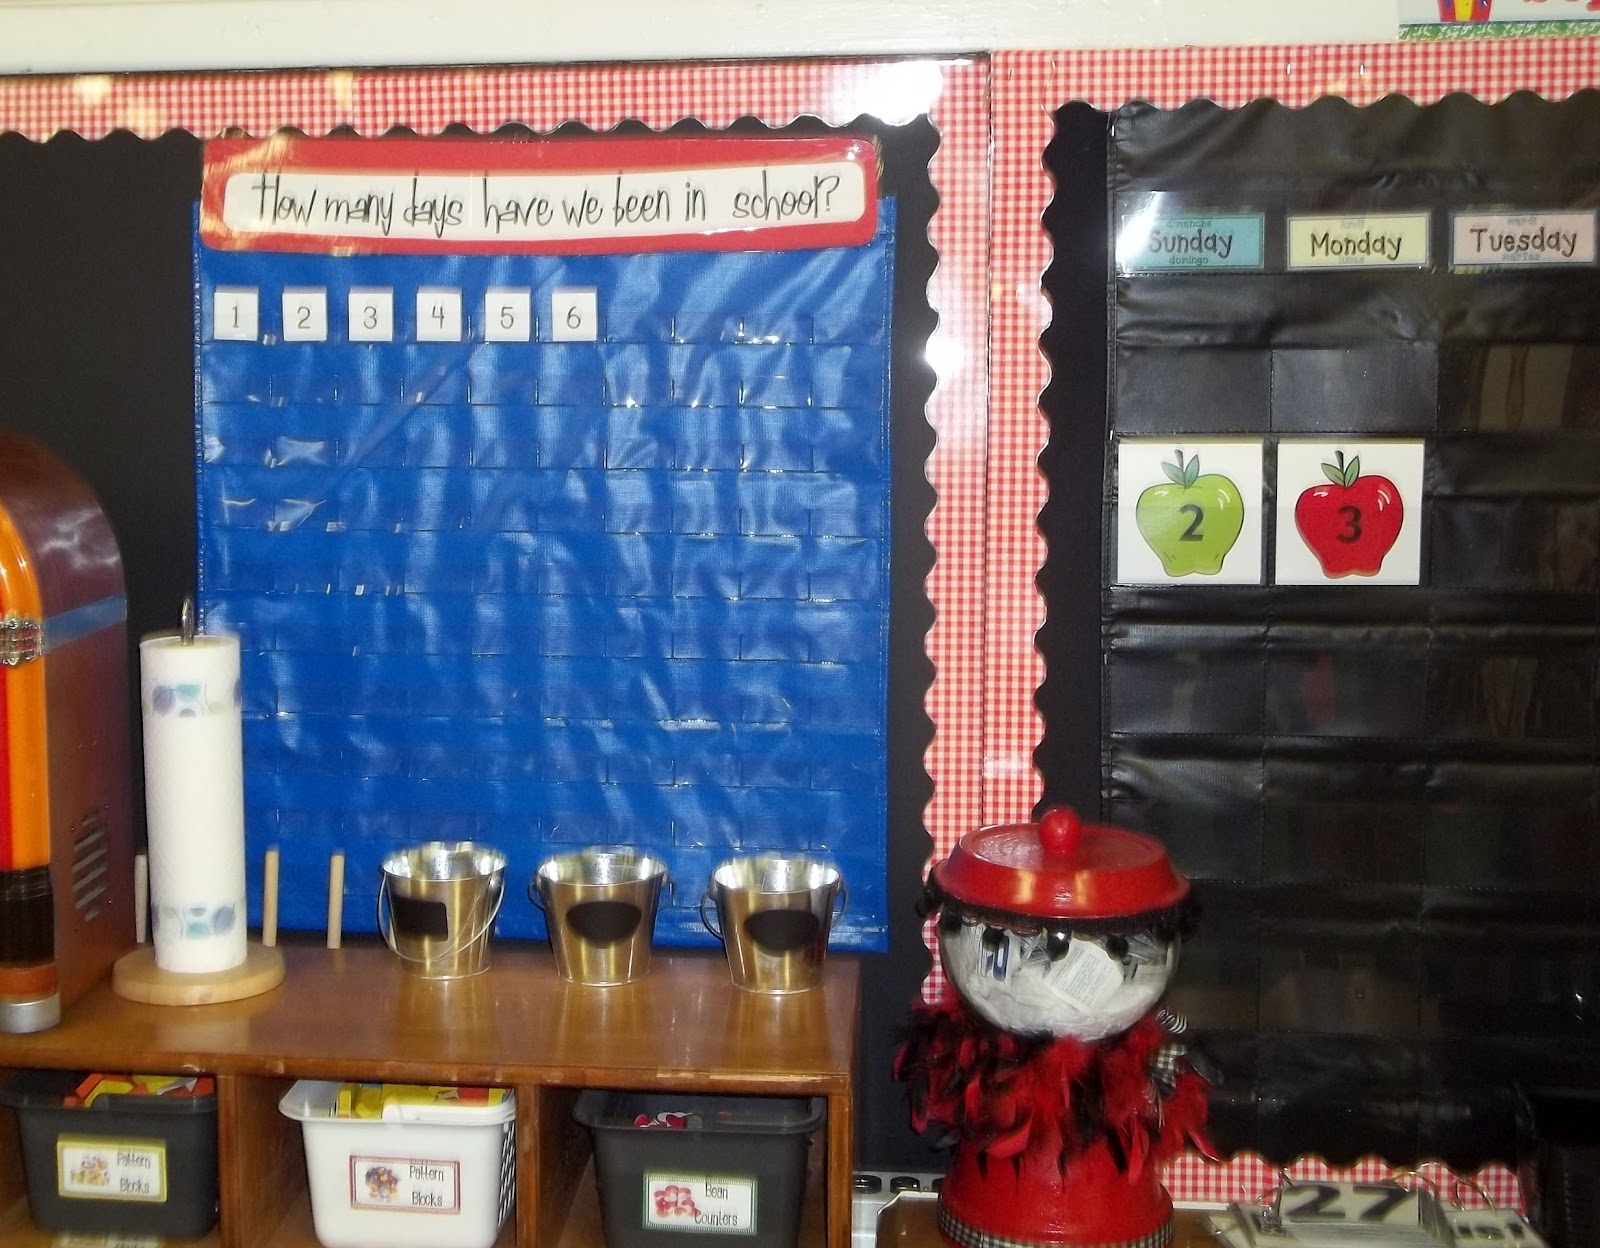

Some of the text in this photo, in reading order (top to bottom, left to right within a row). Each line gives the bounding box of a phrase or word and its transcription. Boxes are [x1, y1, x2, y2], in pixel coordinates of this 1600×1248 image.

[252, 168, 840, 238] How many days have we been in school?
[1149, 228, 1233, 259] Sunday
[1310, 230, 1402, 261] Monday
[1469, 226, 1577, 258] Tuesday
[1168, 254, 1209, 266] domingo
[296, 305, 312, 330] 2
[362, 305, 378, 330] 3
[430, 305, 446, 330] 4
[499, 305, 515, 330] 5
[565, 305, 582, 330] 6
[1177, 503, 1205, 542] 2
[1336, 504, 1363, 544] 3
[116, 1152, 151, 1169] Pattern
[120, 1178, 150, 1194] Blocks
[409, 1165, 444, 1182] Pattern
[412, 1191, 443, 1207] Blocks
[705, 1182, 728, 1199] Bean
[1283, 1184, 1417, 1223] 27
[694, 1208, 738, 1226] Counters
